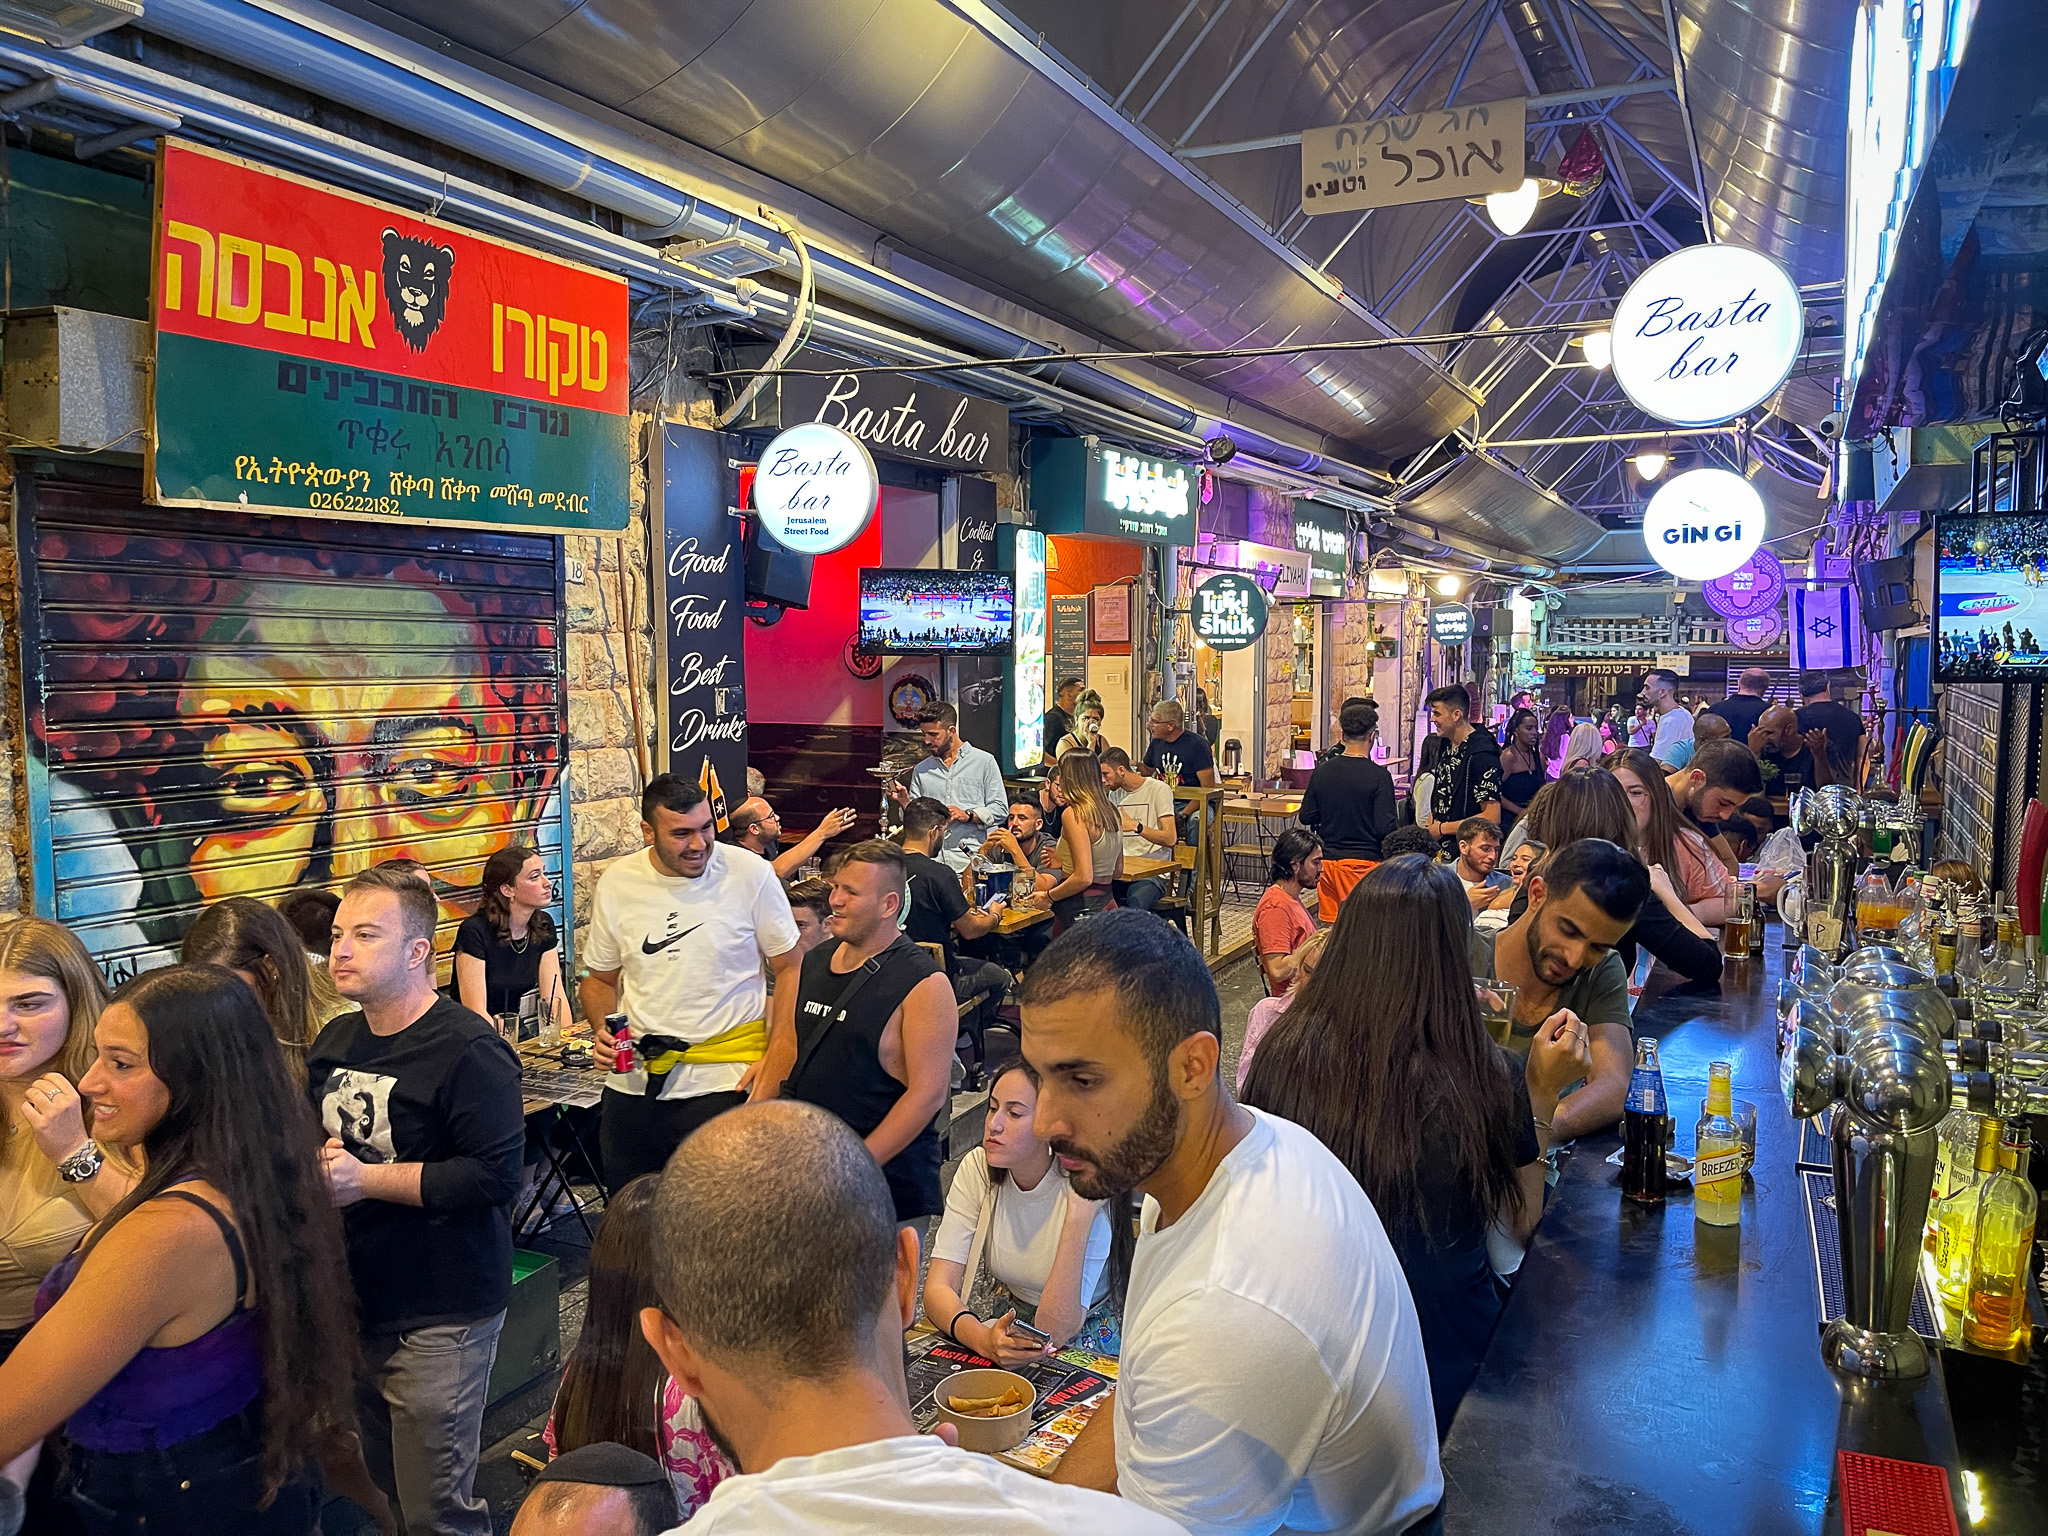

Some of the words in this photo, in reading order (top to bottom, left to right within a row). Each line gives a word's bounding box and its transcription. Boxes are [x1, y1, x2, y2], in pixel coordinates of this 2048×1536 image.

[1335, 113, 1424, 150] שמח
[1438, 106, 1490, 134] חג
[1381, 139, 1504, 188] אוכל
[165, 219, 378, 350] אנבסה
[1636, 288, 1772, 337] Basta
[1654, 335, 1739, 382] bar
[277, 360, 459, 420] התבלינים
[492, 398, 570, 437] מרכז
[813, 373, 926, 450] Basta
[928, 396, 990, 464] bar
[768, 448, 851, 477] Basta
[779, 479, 831, 511] bar
[783, 527, 808, 535] Street
[810, 527, 829, 535] Food
[786, 516, 827, 526] Jerusalem
[959, 516, 997, 543] Cocktail
[571, 561, 583, 579] 18
[668, 537, 732, 584] Good
[669, 594, 727, 637] Food
[670, 652, 737, 695] Best
[671, 708, 748, 752] Drinks
[804, 1000, 823, 1015] STAY
[930, 1347, 969, 1362] BASTA
[1063, 1376, 1101, 1395] BASTA
